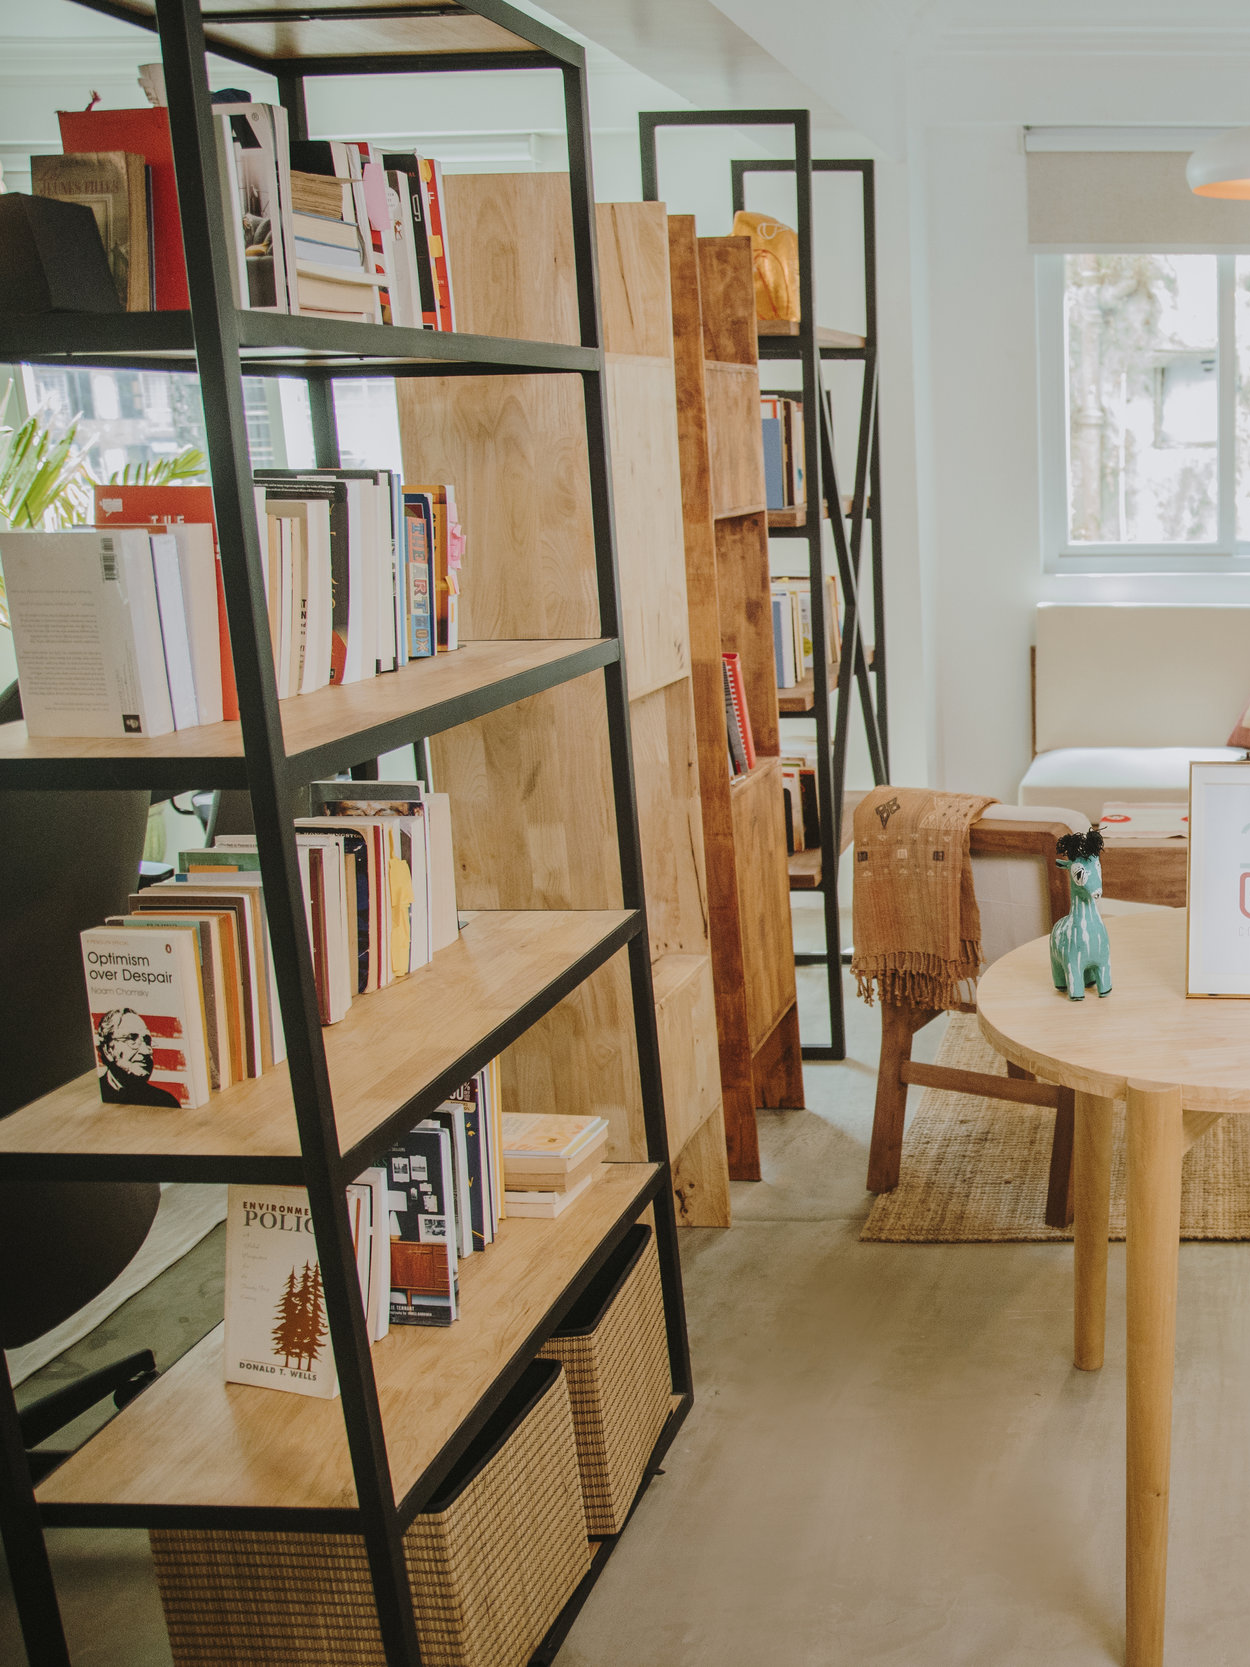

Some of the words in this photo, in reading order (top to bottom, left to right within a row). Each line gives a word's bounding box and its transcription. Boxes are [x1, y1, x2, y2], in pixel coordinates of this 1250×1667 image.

[87, 951, 150, 967] Optimism
[89, 969, 117, 981] over
[122, 968, 172, 985] Despair
[91, 986, 114, 996] Noam
[115, 987, 150, 998] Chomsky
[242, 1201, 310, 1217] ENVIRONME
[242, 1209, 315, 1235] POLIC
[239, 1361, 276, 1375] DONALD
[279, 1368, 287, 1377] T.
[290, 1369, 318, 1382] WELLS
